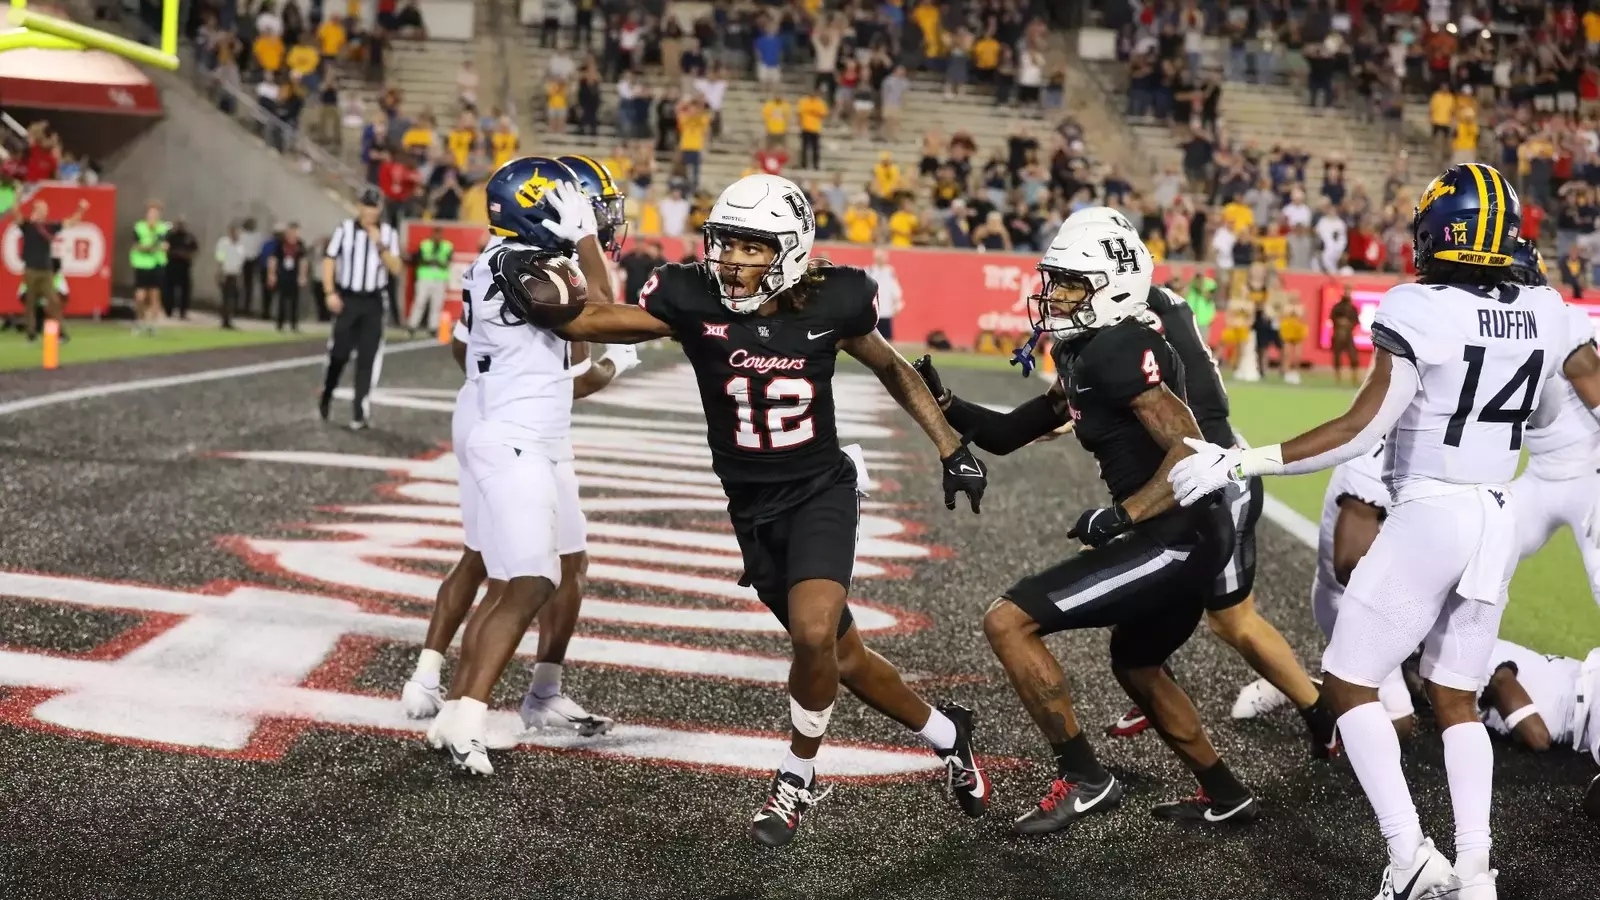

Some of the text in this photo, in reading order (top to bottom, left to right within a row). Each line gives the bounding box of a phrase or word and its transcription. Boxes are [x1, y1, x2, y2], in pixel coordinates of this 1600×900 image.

[1454, 232, 1467, 245] 14
[1098, 236, 1142, 276] UH
[703, 322, 730, 340] XII
[1477, 309, 1538, 339] RUFFIN
[728, 348, 807, 373] Cougars
[1141, 349, 1163, 384] 4
[725, 375, 817, 450] 12
[1443, 345, 1545, 450] 14
